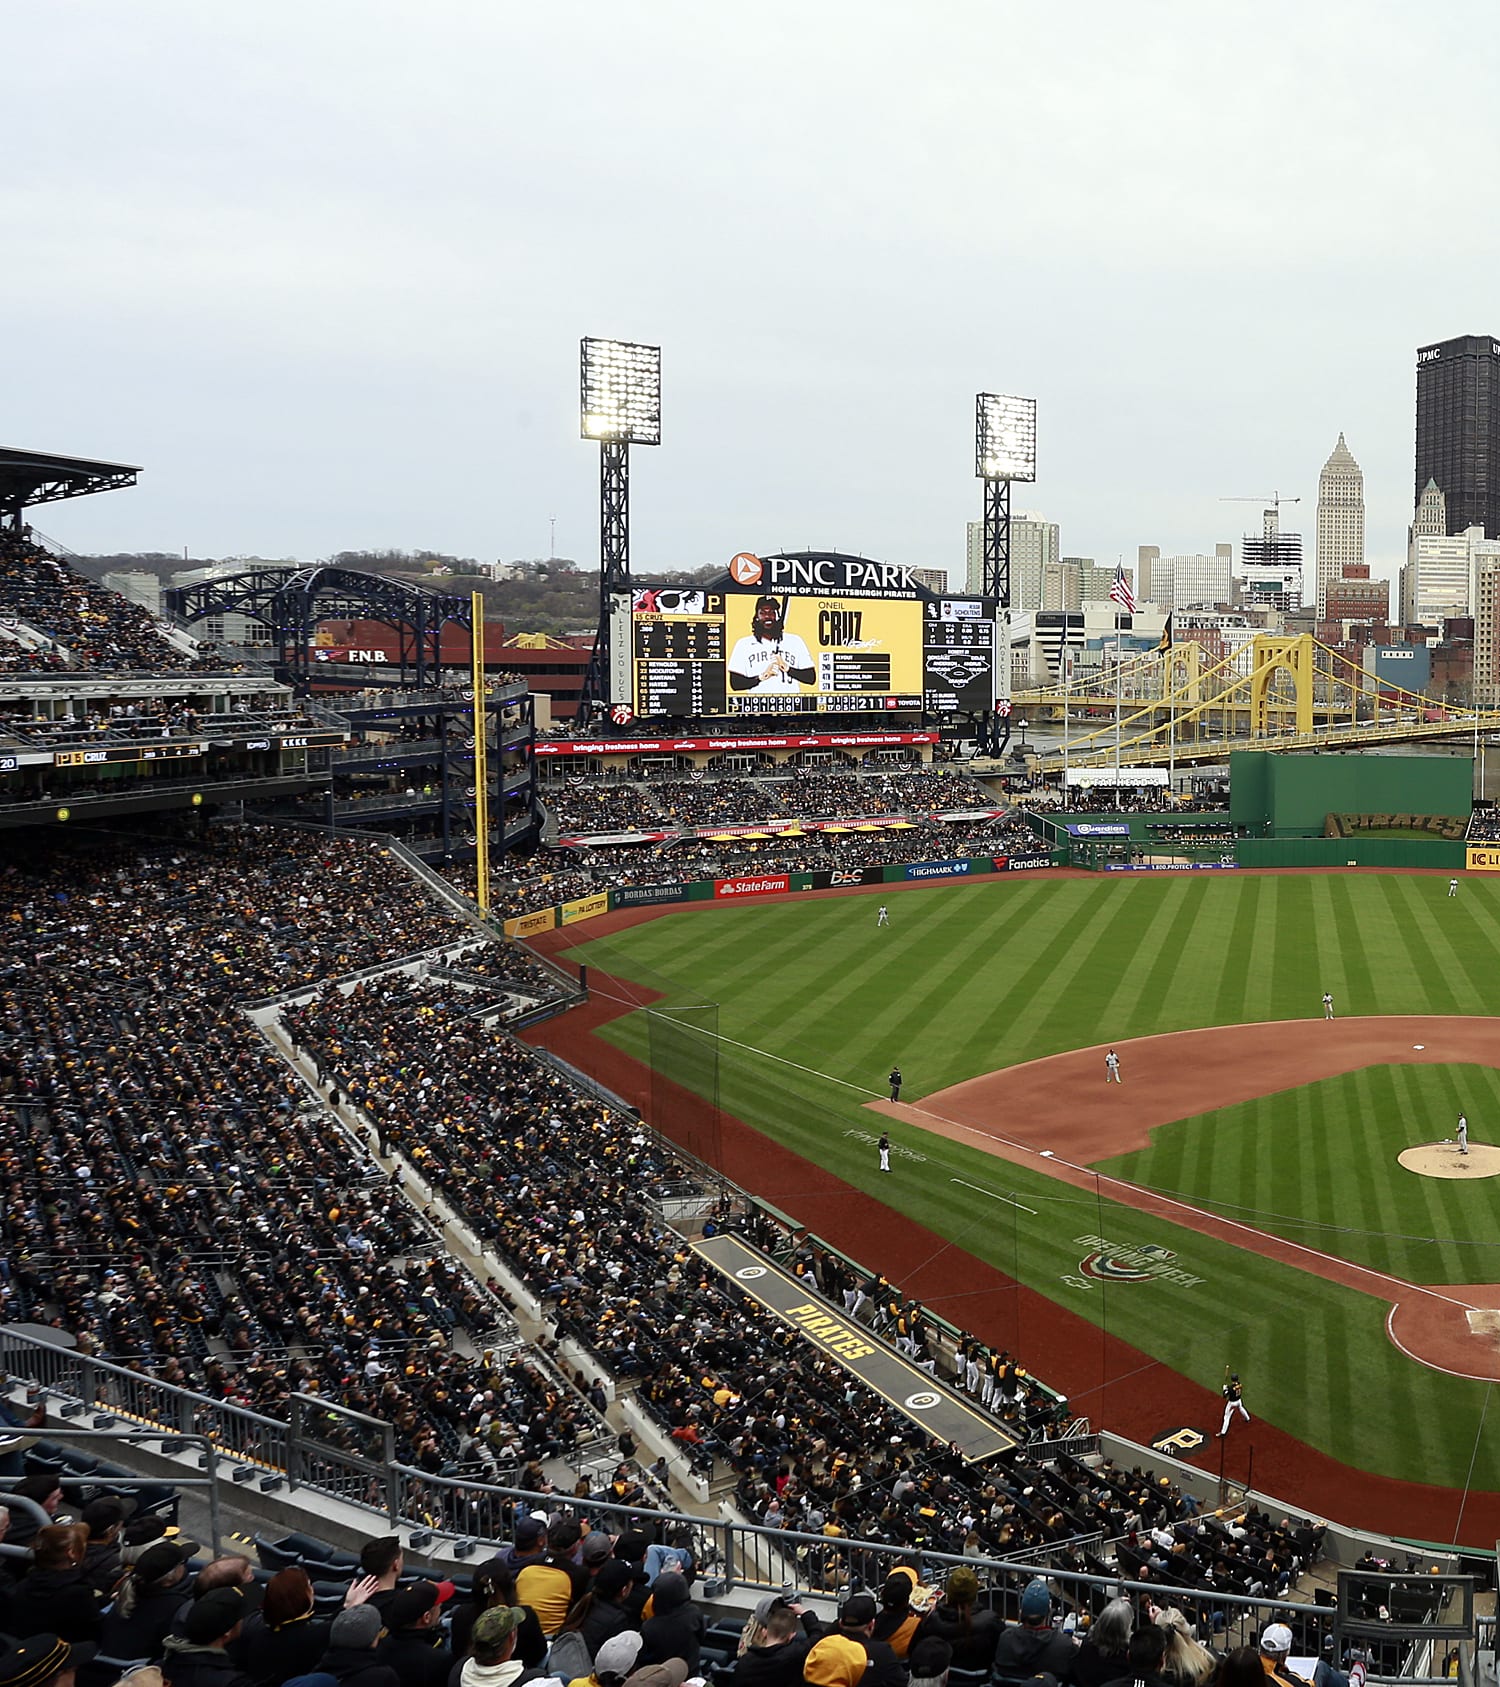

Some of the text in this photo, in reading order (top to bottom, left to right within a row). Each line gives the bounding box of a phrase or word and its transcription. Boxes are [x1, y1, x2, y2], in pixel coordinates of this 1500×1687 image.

[1417, 348, 1440, 363] UPMC
[768, 558, 918, 589] PNC PARK
[772, 586, 797, 594] HOME
[832, 588, 882, 598] PITTSBURGH
[884, 590, 916, 598] PIRATES
[707, 595, 720, 612] P
[818, 601, 845, 610] ONEIL
[818, 610, 862, 646] CRUZ
[349, 650, 388, 662] F.N.B.
[573, 744, 604, 752] bringing
[84, 752, 108, 762] CRUZ
[1094, 778, 1111, 786] FAT
[1077, 824, 1125, 834] Guardian
[1339, 813, 1469, 839] PIRATES
[1008, 857, 1050, 870] Fanatics
[1472, 853, 1486, 866] IC
[830, 868, 864, 885] DLC
[911, 866, 952, 877] HIGHMARK
[624, 887, 682, 899] BORDAS BORDAS
[586, 900, 606, 913] LOTTERY
[520, 915, 548, 929] TRISTATE
[1072, 1234, 1208, 1288] OPENING WEEK
[785, 1304, 875, 1360] PIRATES
[1152, 1428, 1204, 1449] P
